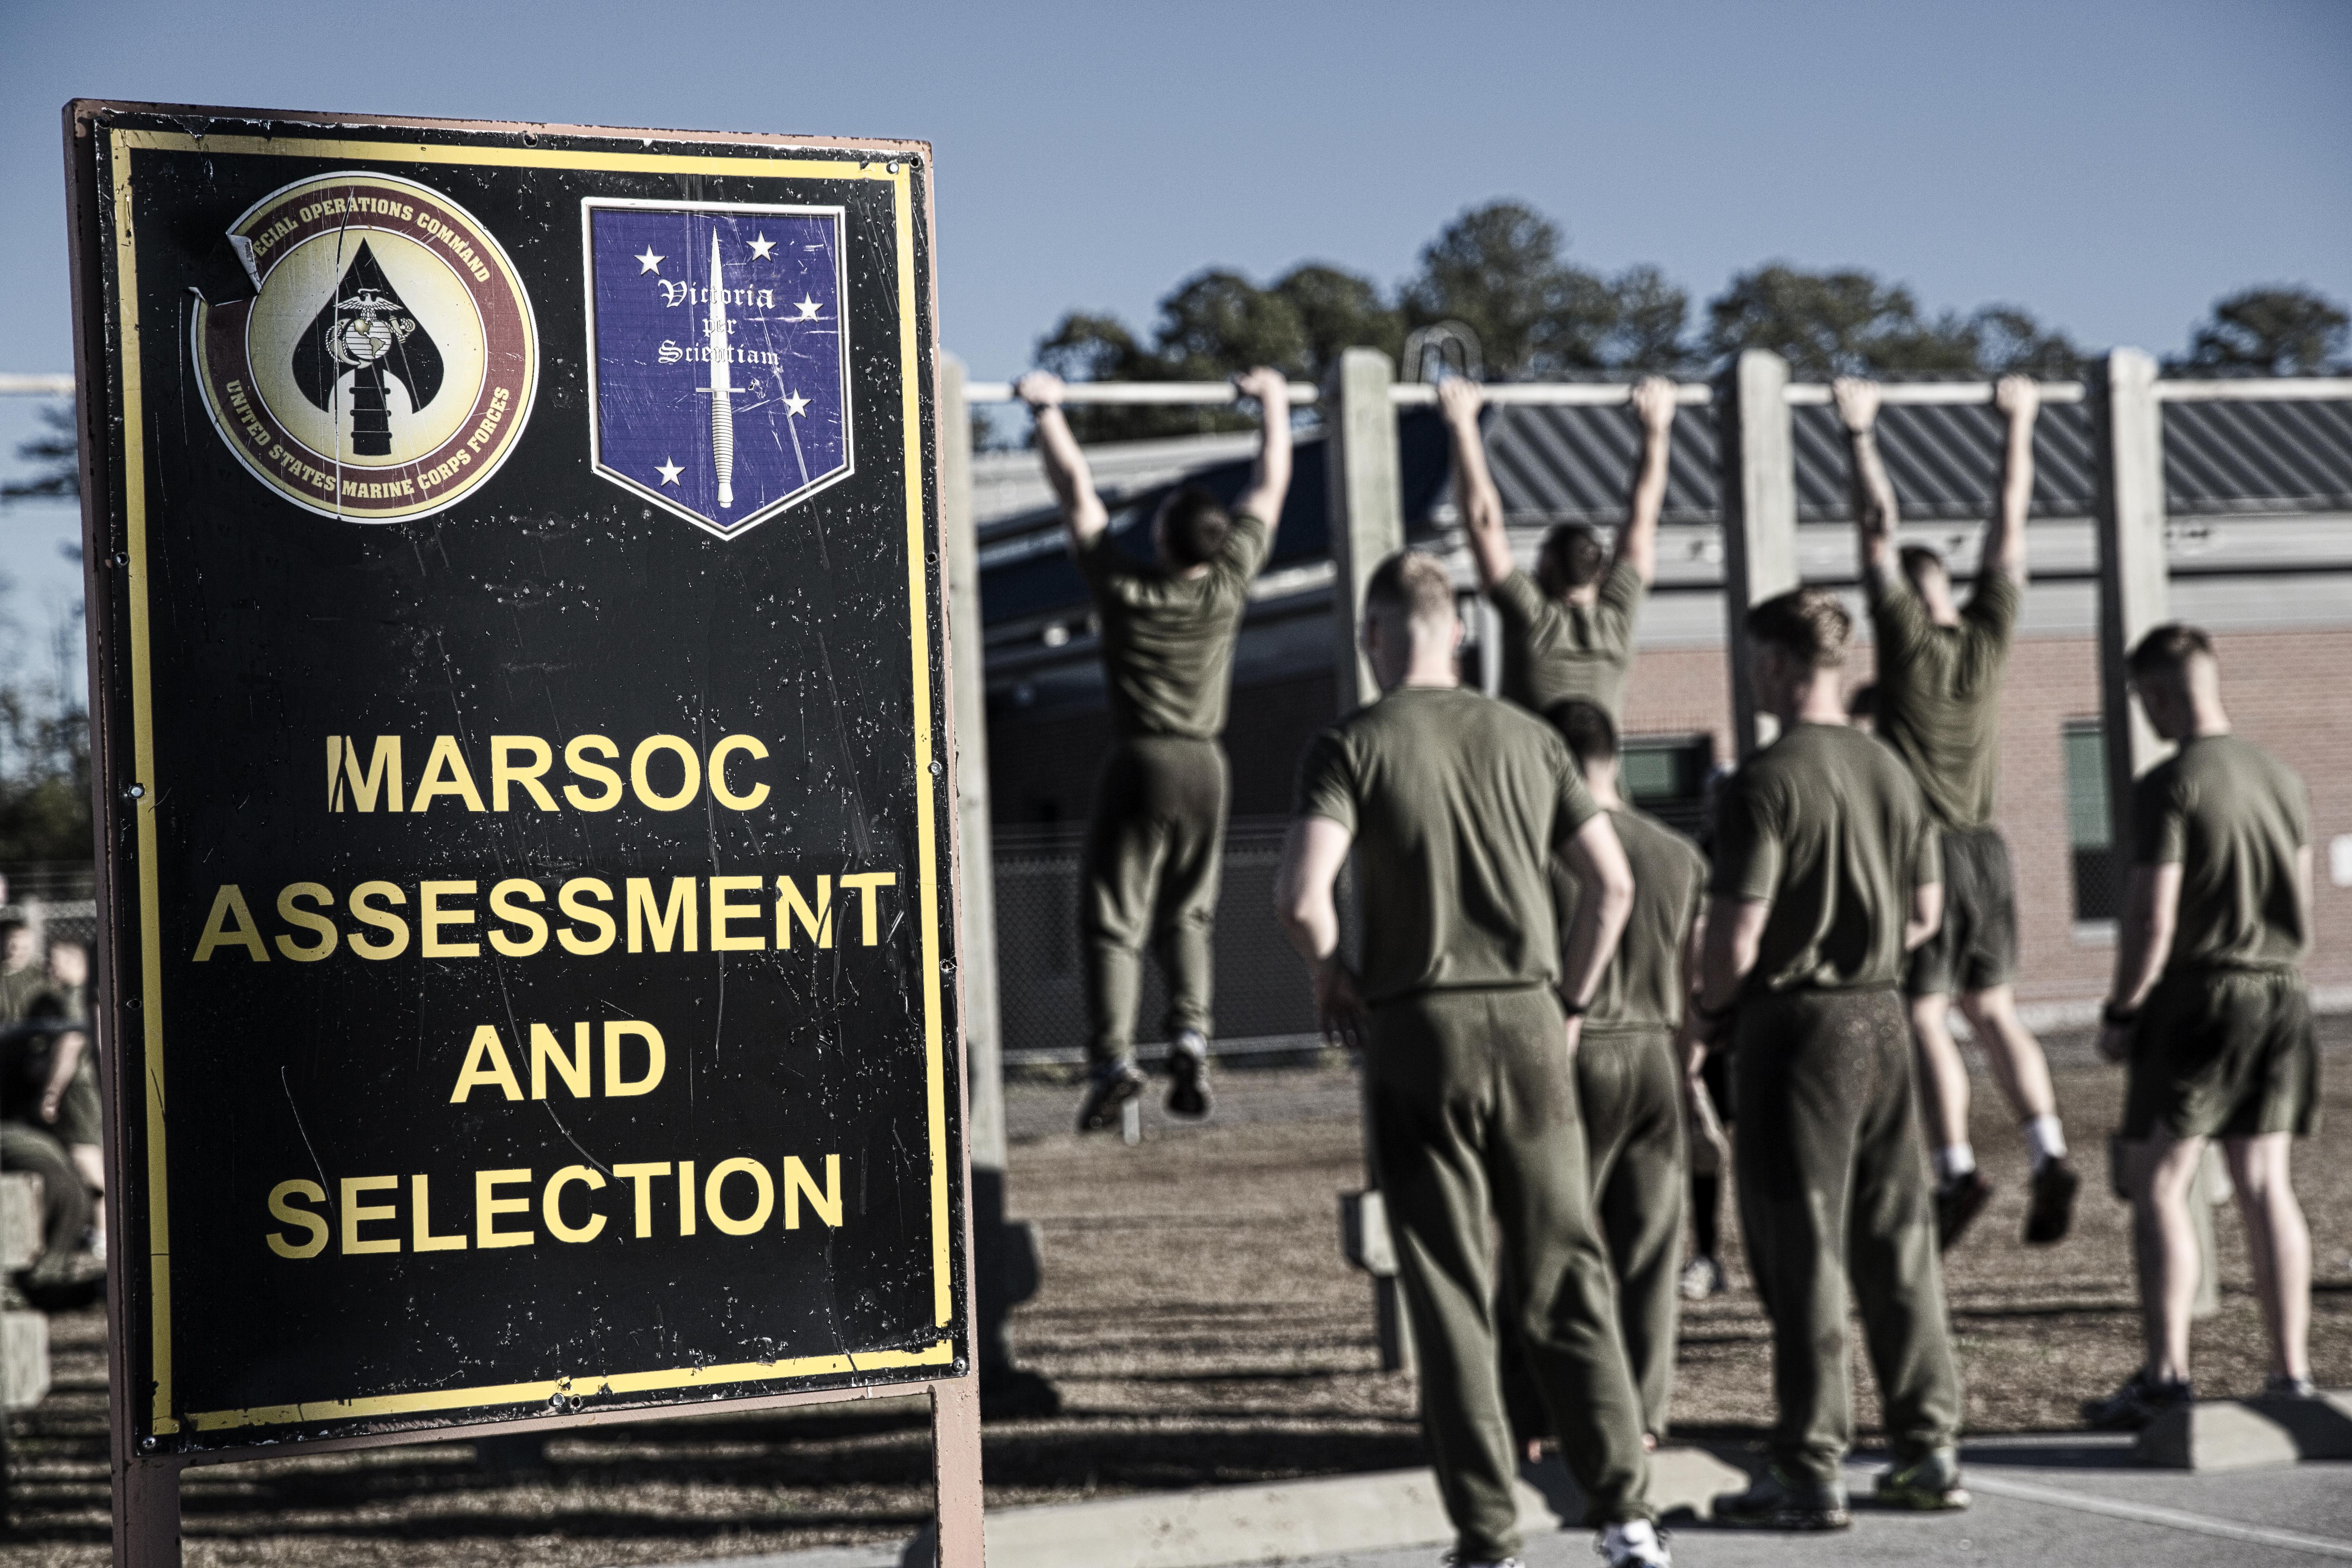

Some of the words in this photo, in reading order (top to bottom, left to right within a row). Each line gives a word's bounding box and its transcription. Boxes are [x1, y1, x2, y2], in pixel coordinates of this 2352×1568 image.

[252, 216, 298, 258] ECIAL
[299, 197, 413, 223] OPERATIONS
[416, 213, 491, 283] COMMAND
[658, 279, 776, 310] Victoria
[702, 318, 737, 337] per
[658, 339, 779, 365] Scientiam
[225, 379, 272, 446] UNITED
[268, 444, 337, 492] STATES
[341, 478, 415, 499] MARINE
[417, 450, 472, 489] CORPS
[470, 386, 510, 453] FORCES
[326, 734, 771, 813] MARSOC
[192, 872, 897, 962] ASSESSMENT
[450, 1020, 667, 1104] AND
[265, 1154, 843, 1259] SELECTION
